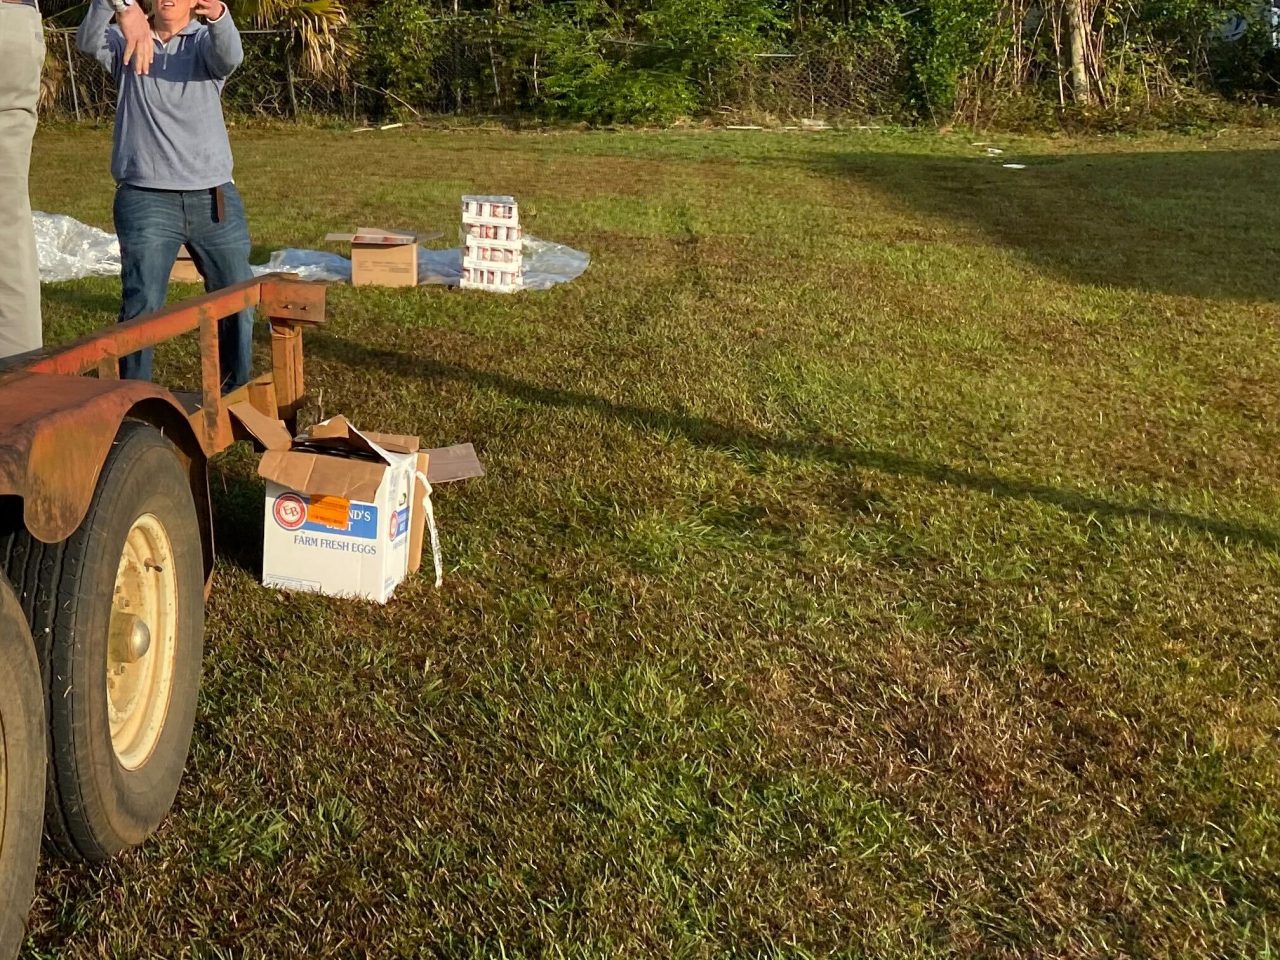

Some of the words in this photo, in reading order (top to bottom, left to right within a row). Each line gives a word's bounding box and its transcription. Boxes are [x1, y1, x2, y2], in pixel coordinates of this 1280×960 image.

[294, 534, 318, 547] FARM
[320, 538, 350, 552] FRESH
[351, 543, 377, 556] EGGS
